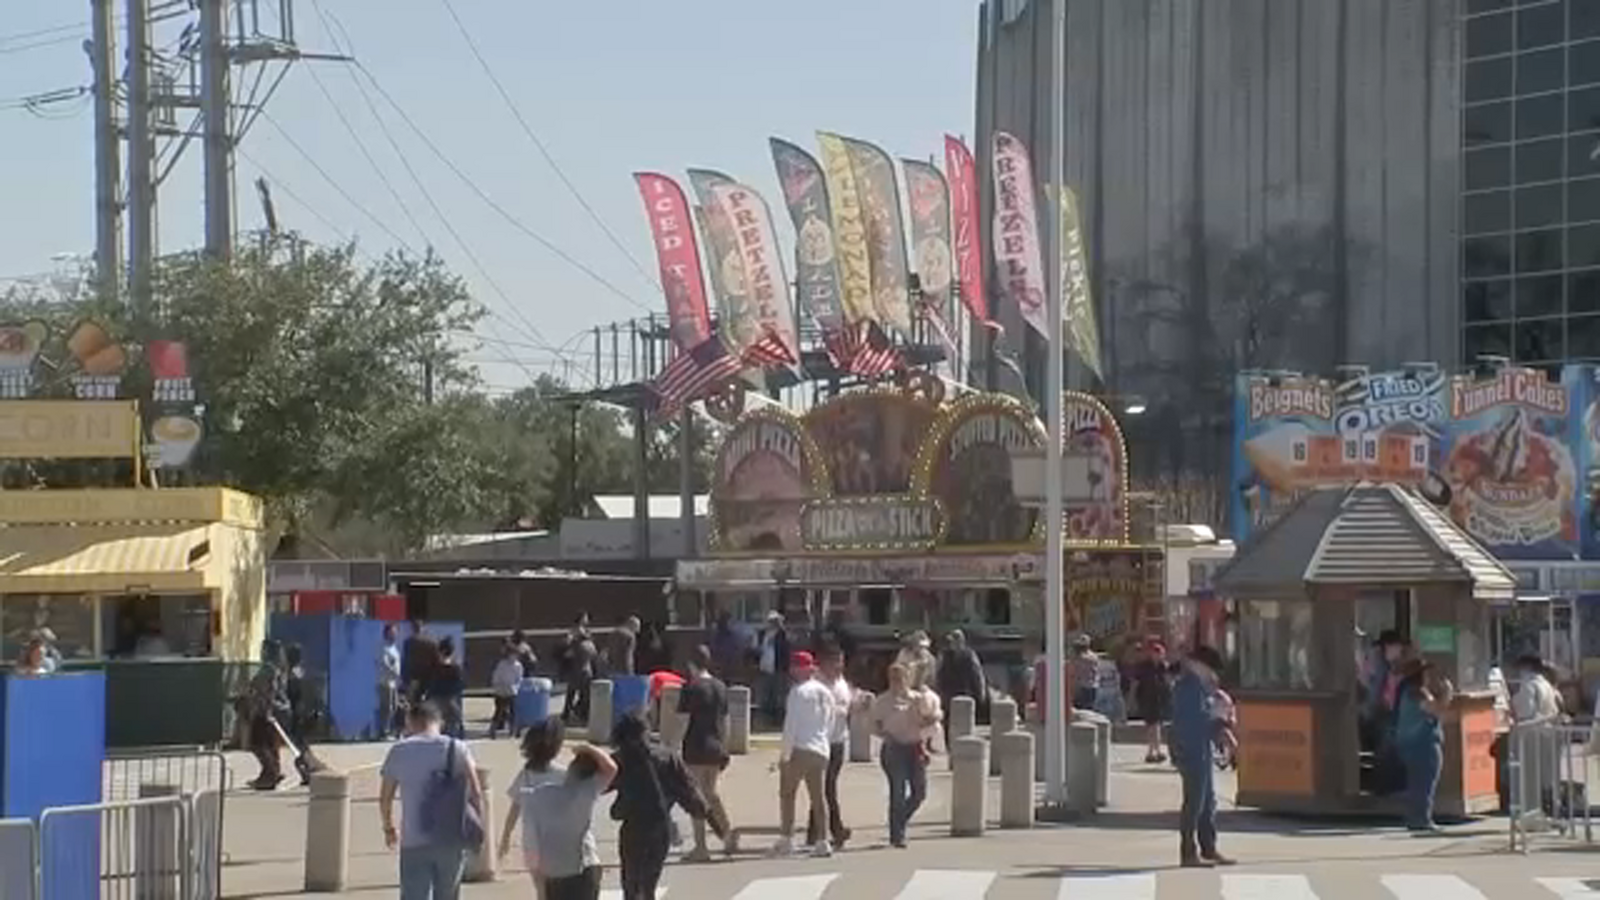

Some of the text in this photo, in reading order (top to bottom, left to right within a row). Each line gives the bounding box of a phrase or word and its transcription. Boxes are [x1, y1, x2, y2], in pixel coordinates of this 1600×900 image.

[654, 179, 683, 250] ICED
[1251, 386, 1332, 419] Beignets
[1371, 378, 1422, 400] FRIED
[1451, 372, 1565, 417] Funnel Cakes
[811, 508, 858, 538] PIZZA
[888, 506, 932, 538] STICK
